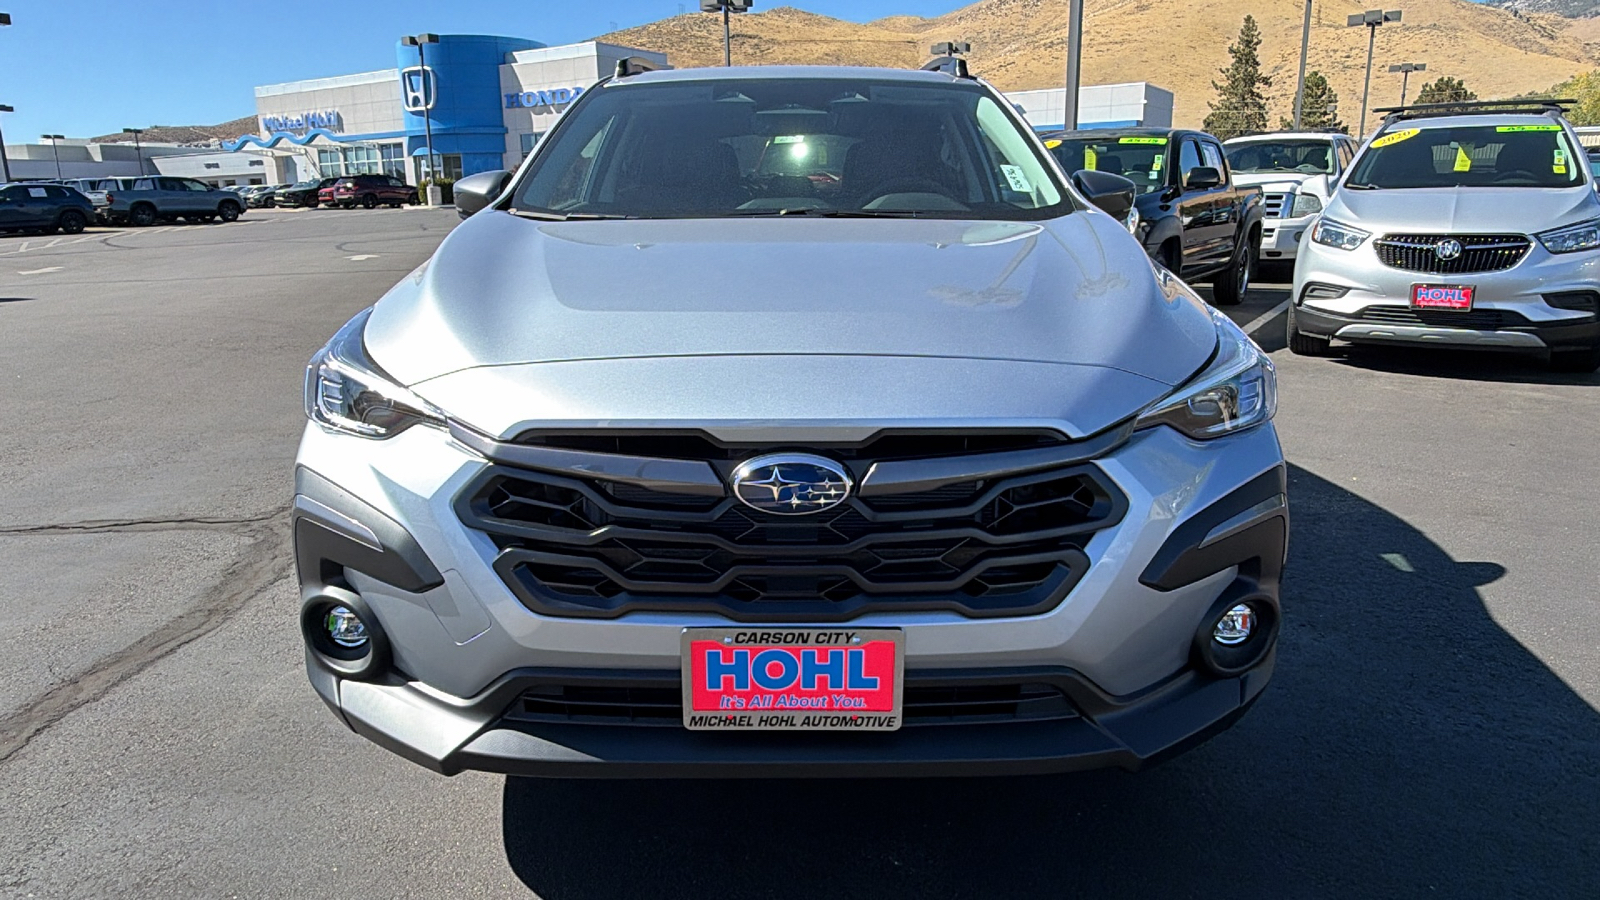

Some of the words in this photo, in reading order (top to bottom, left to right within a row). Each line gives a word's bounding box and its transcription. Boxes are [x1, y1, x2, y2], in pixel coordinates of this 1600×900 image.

[504, 87, 585, 108] HONDA
[1381, 131, 1411, 145] 2020
[1417, 288, 1466, 301] HOHL
[734, 632, 810, 644] CARSON
[815, 632, 855, 644] CITY
[706, 649, 880, 691] HOHL
[720, 695, 745, 708] It's
[748, 695, 773, 708] All
[775, 695, 828, 708] About
[831, 695, 866, 708] You.
[689, 715, 753, 728] MICHAEL
[758, 716, 796, 728] HOHL
[801, 715, 896, 728] AUTOMOTIVE
